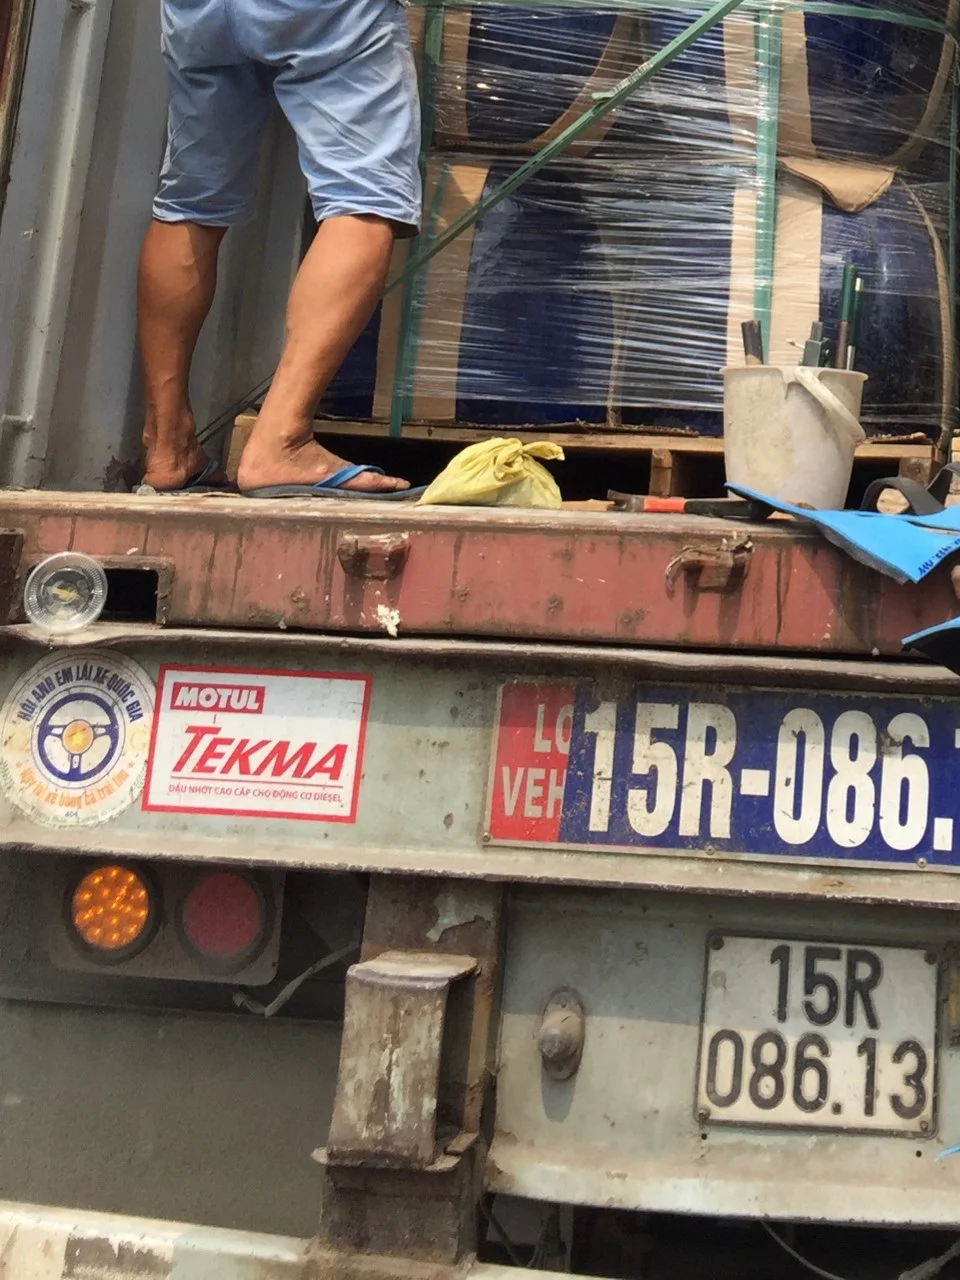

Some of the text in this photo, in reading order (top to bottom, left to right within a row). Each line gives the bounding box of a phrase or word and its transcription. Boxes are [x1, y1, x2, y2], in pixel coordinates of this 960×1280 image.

[32, 678, 56, 703] ANH
[55, 666, 74, 687] EM
[76, 662, 93, 681] LÁI
[94, 666, 111, 685] XE
[125, 699, 144, 723] GIA
[174, 686, 261, 711] MOTUL
[171, 725, 349, 781] TEKMA
[214, 786, 233, 797] CAO
[252, 788, 271, 798] CHO
[769, 943, 883, 1030] 15R
[705, 1028, 929, 1121] 086.13
